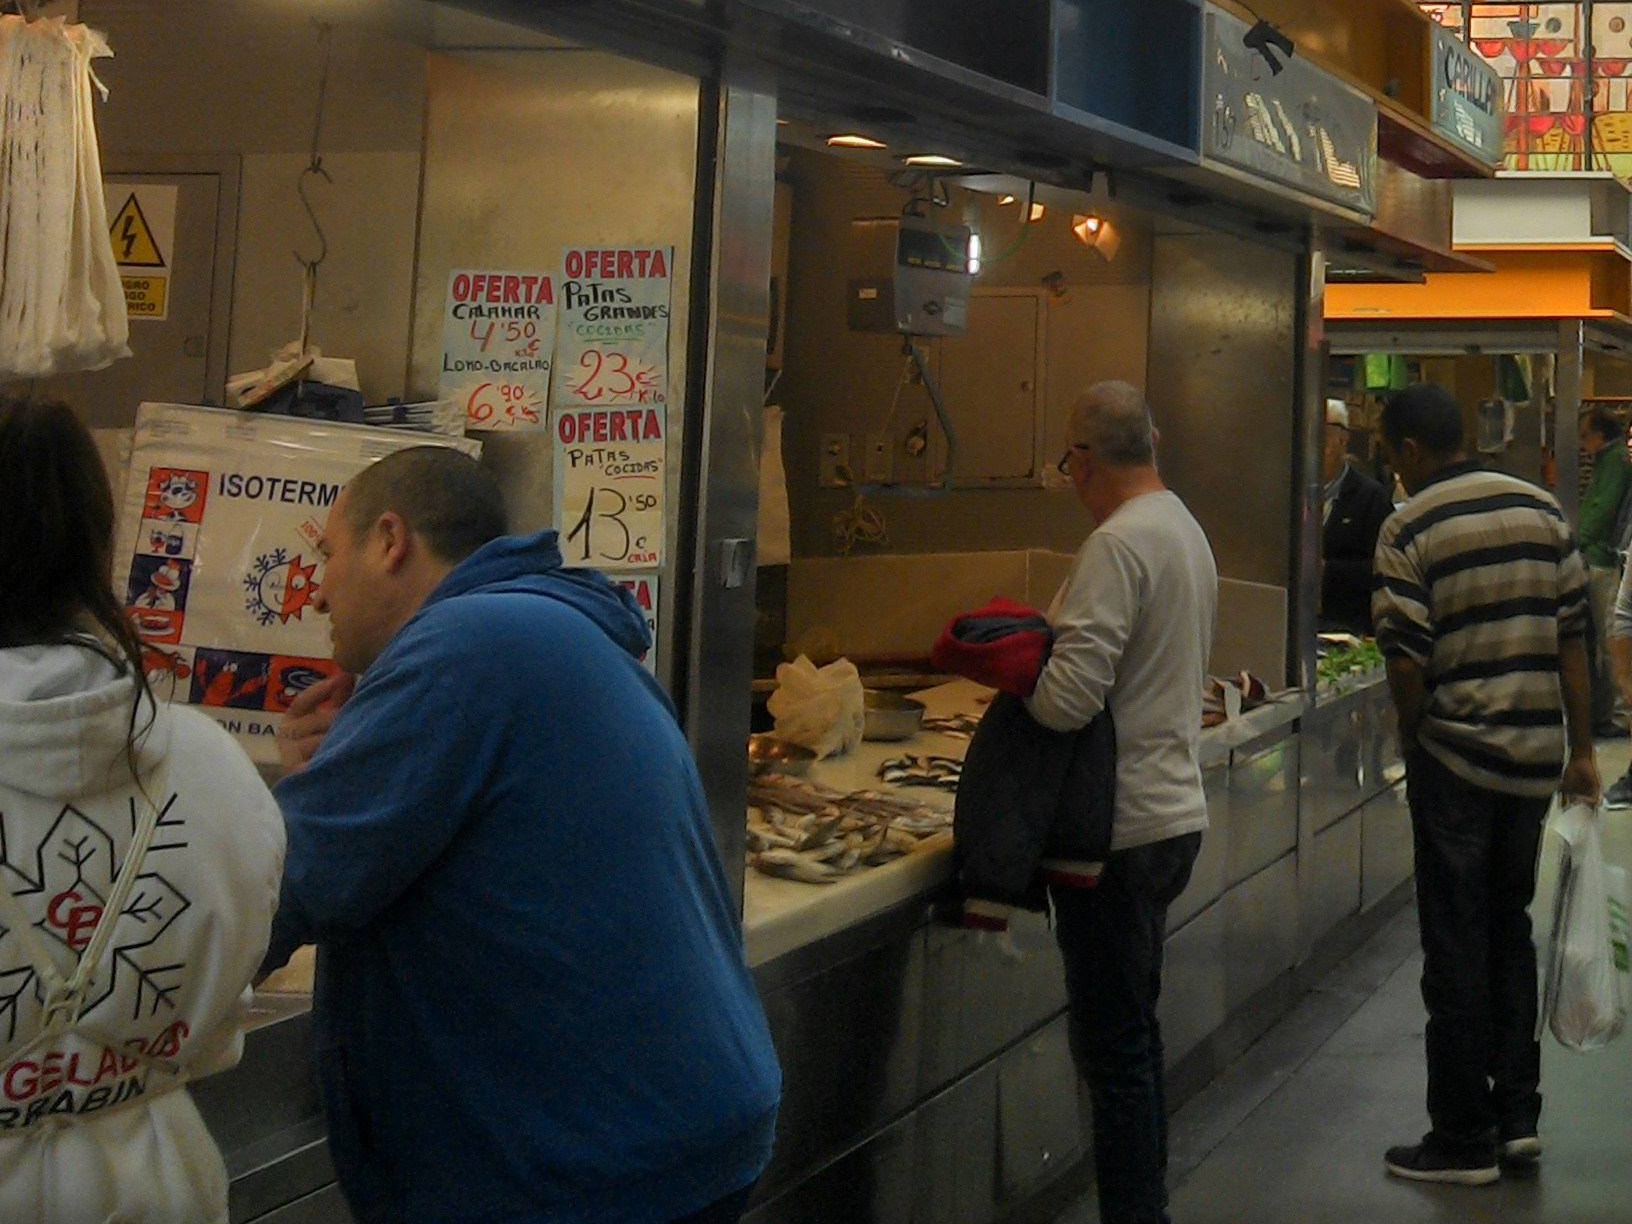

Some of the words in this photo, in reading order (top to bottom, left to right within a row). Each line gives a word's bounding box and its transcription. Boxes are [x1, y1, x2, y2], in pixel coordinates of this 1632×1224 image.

[565, 250, 667, 279] OFERTA
[452, 274, 554, 304] OFERTA
[452, 303, 541, 320] CALAMAR
[583, 304, 669, 321] GRANDES
[558, 409, 661, 444] OFERTA
[219, 473, 343, 507] ISOTERM
